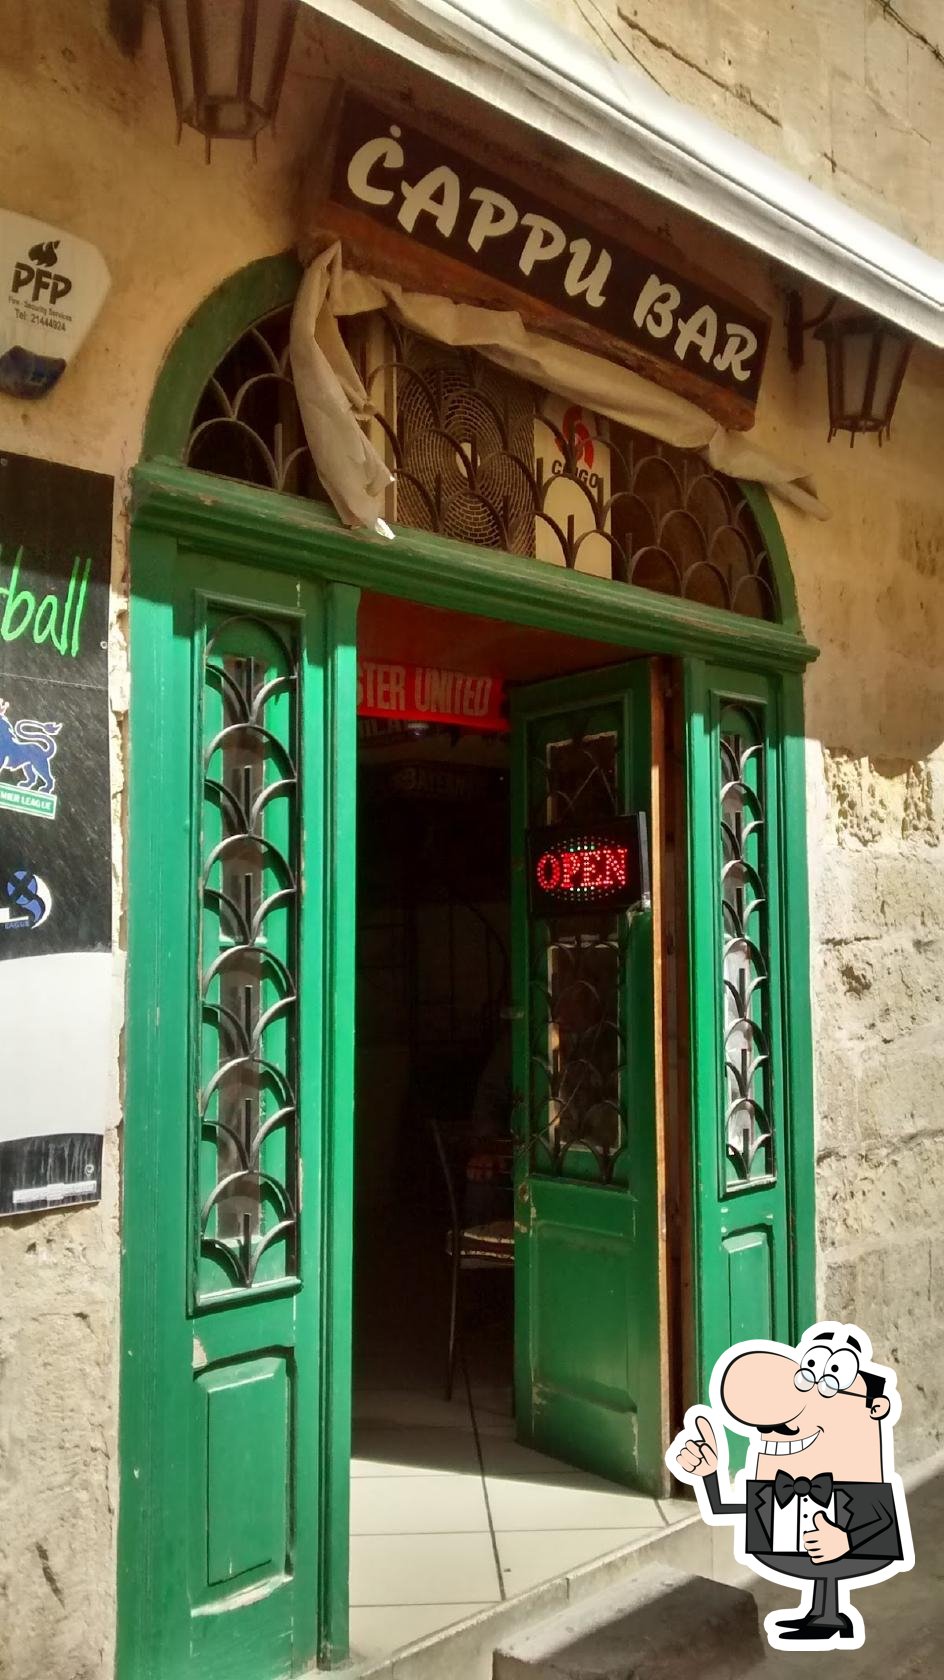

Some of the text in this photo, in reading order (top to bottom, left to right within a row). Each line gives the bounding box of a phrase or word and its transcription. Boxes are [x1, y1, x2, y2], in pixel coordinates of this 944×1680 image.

[11, 261, 73, 305] PFP
[633, 274, 758, 382] BAR
[0, 545, 92, 658] ball
[414, 666, 493, 717] UNITED
[21, 796, 52, 811] LEAGUE
[537, 848, 628, 889] OPEN
